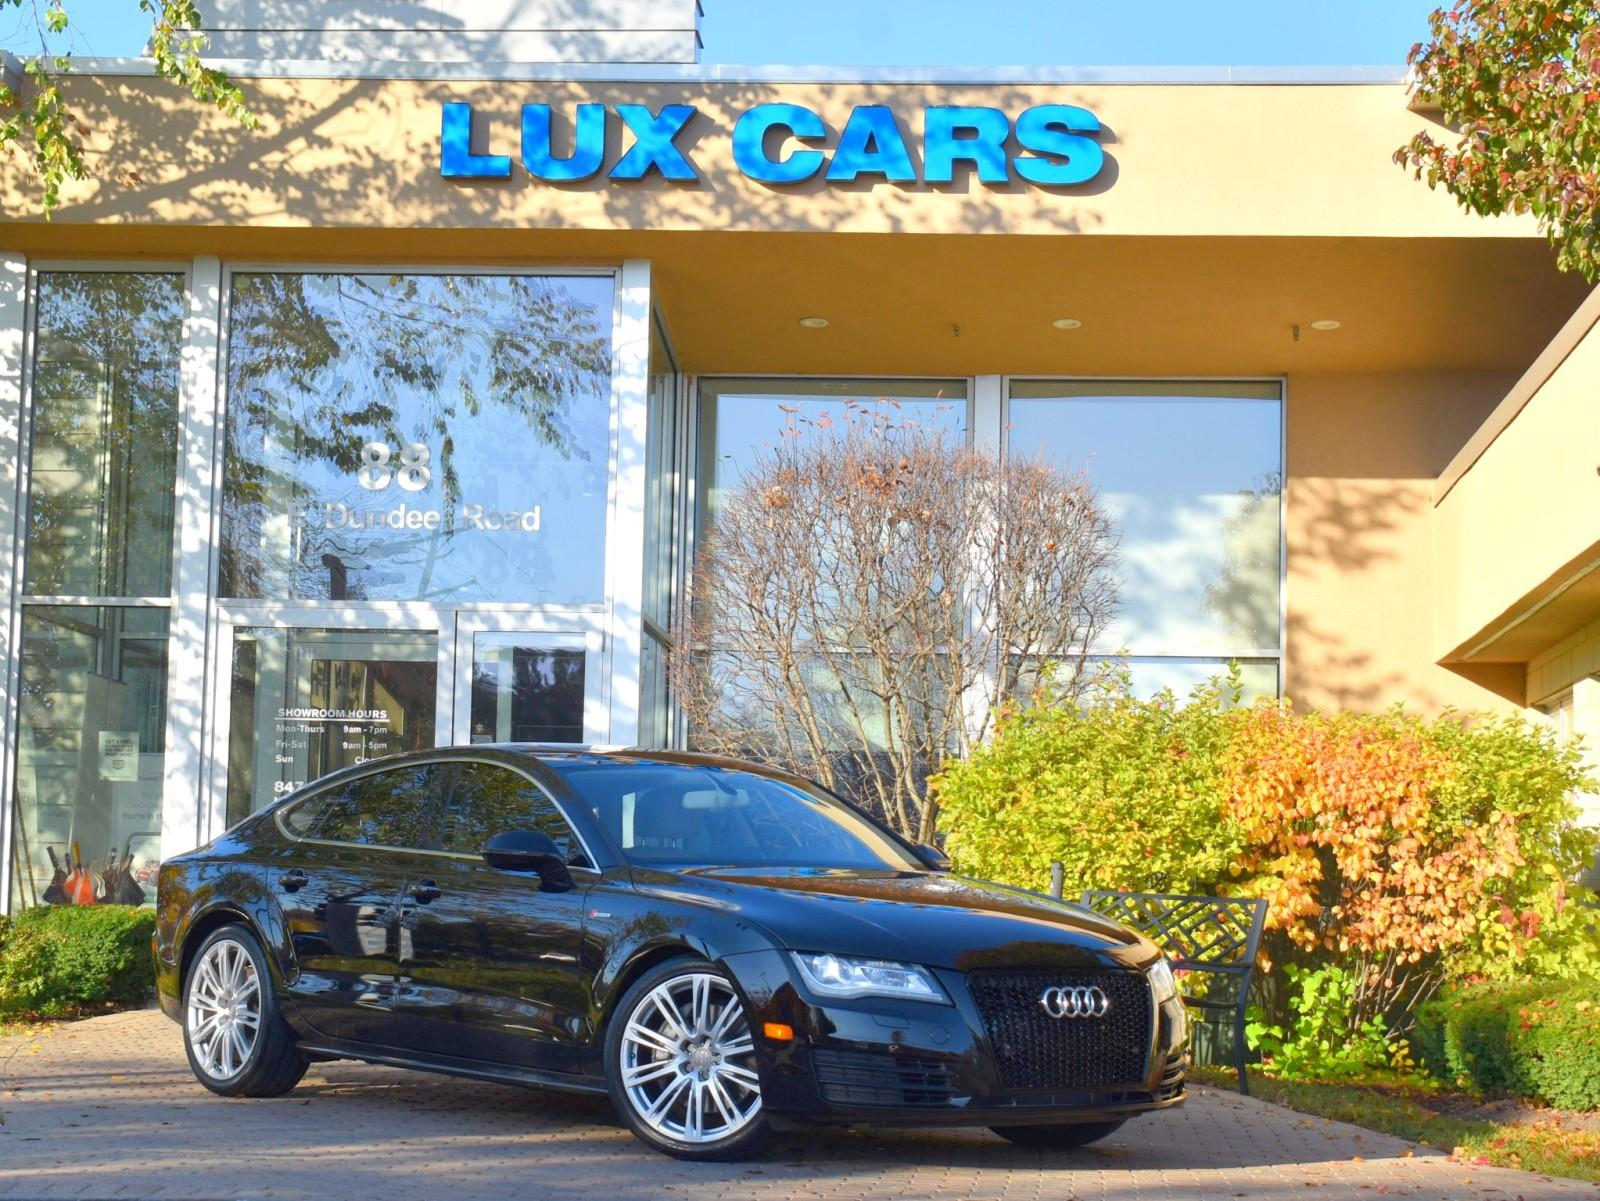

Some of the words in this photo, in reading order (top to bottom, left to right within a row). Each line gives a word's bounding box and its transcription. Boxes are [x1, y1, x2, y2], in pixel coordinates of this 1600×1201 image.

[440, 101, 698, 182] LUX
[731, 102, 1104, 187] CARS
[357, 441, 432, 491] 88
[325, 503, 441, 530] Dundee
[462, 504, 541, 532] Road
[277, 708, 345, 718] SHOWROOM
[347, 709, 388, 719] HOURS
[275, 725, 325, 733] Mon-Thurs
[343, 725, 362, 733] 9am
[368, 726, 388, 735] 7pm
[275, 740, 308, 749] Fri-Sat
[342, 741, 361, 749] 9am
[368, 741, 388, 751] 5pm
[275, 754, 294, 763] Sun
